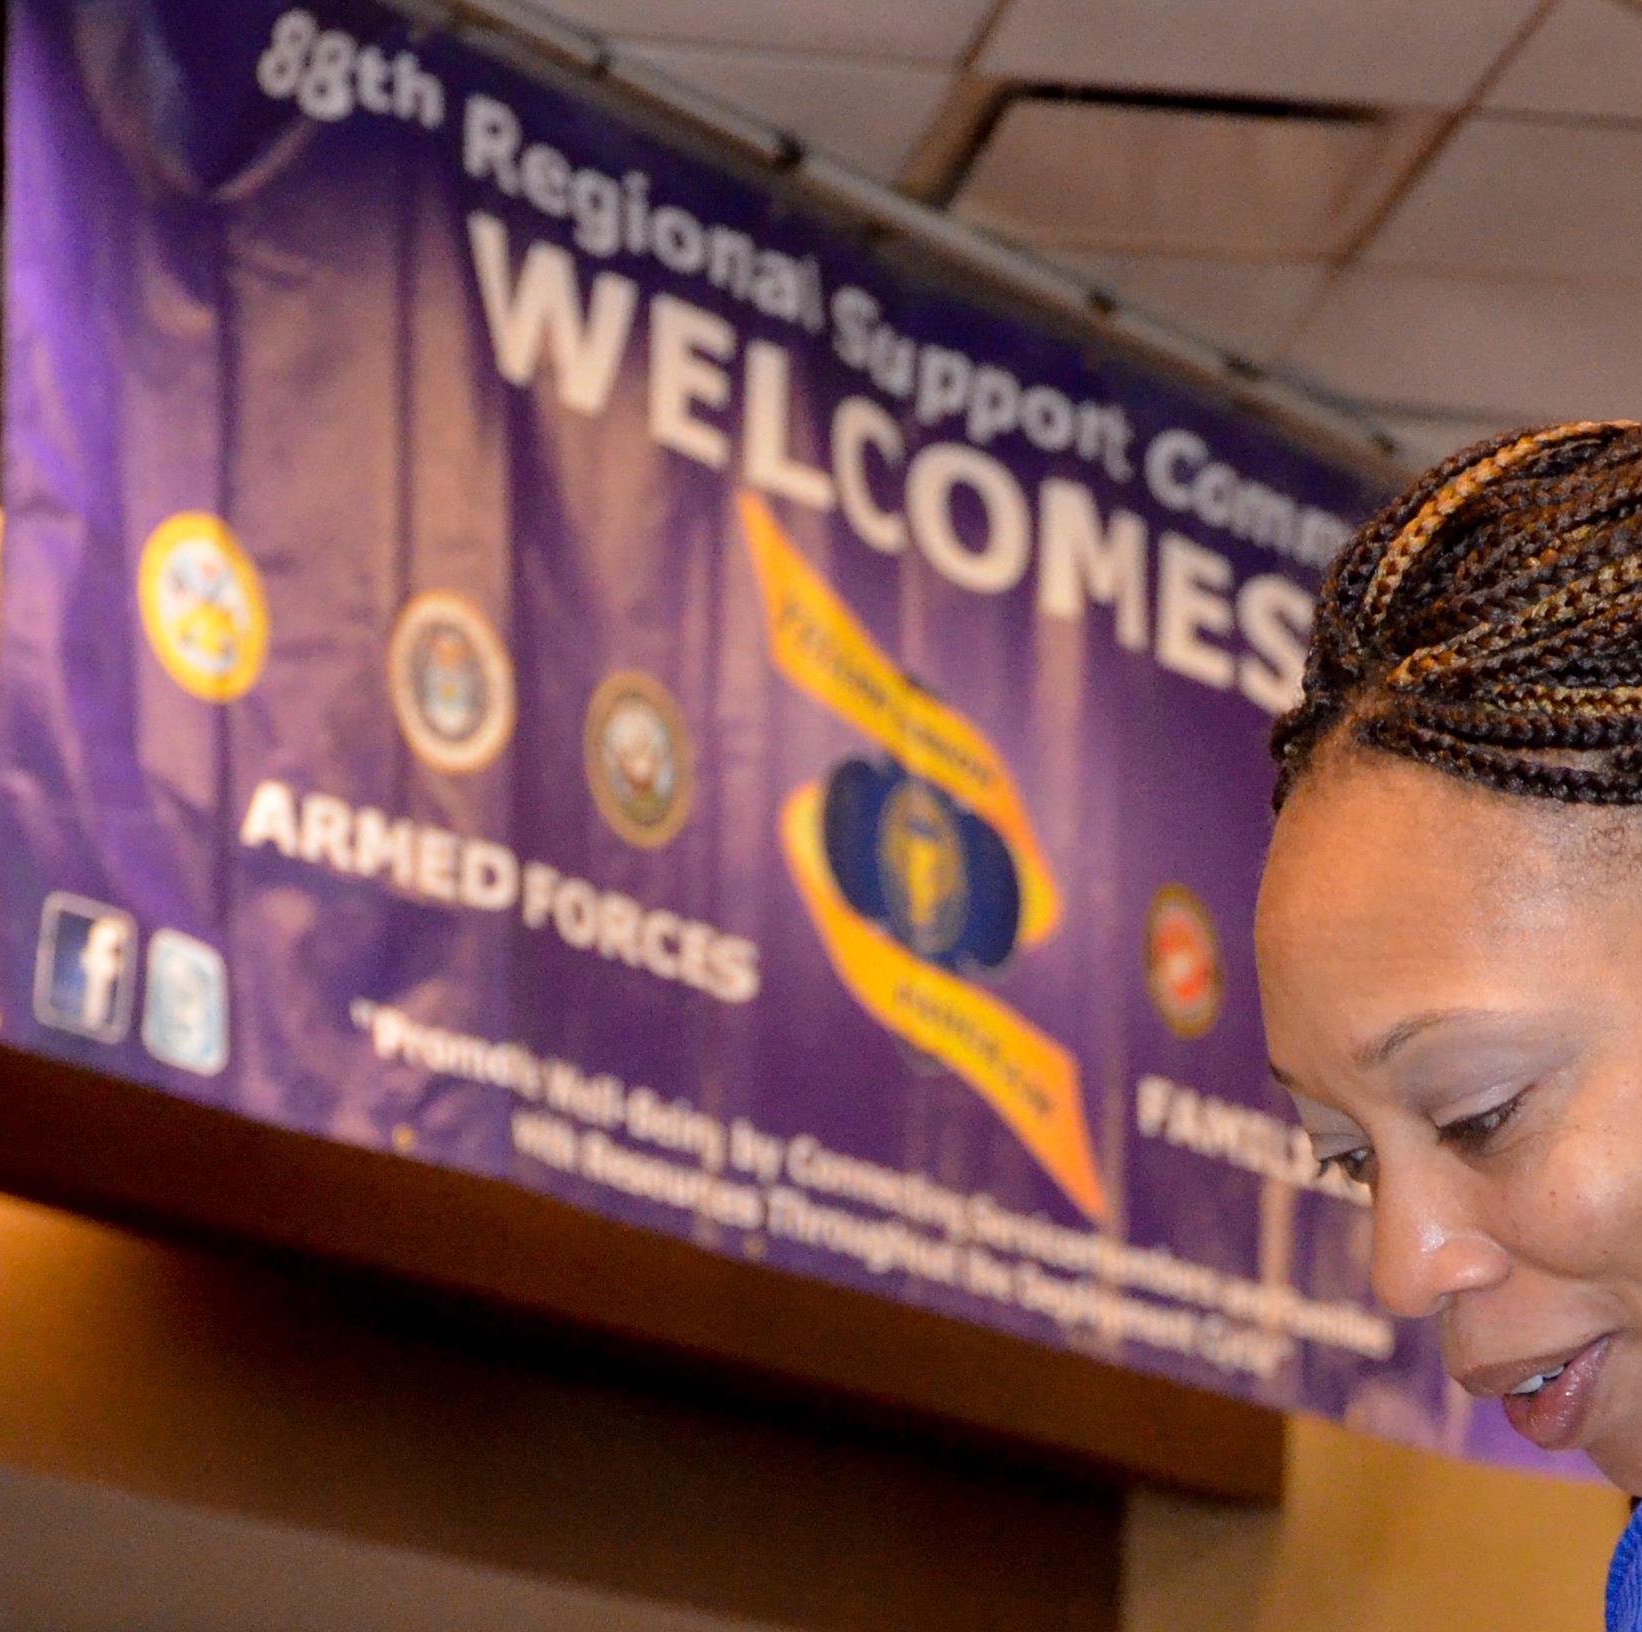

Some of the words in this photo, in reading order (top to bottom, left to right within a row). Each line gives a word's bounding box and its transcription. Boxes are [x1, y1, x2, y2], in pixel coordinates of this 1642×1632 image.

[258, 8, 445, 132] 88th
[464, 95, 823, 335] Regional
[830, 285, 1135, 484] Support
[468, 210, 1317, 715] WELCOMES
[239, 780, 518, 913] ARMED
[522, 859, 760, 1003] FORCES
